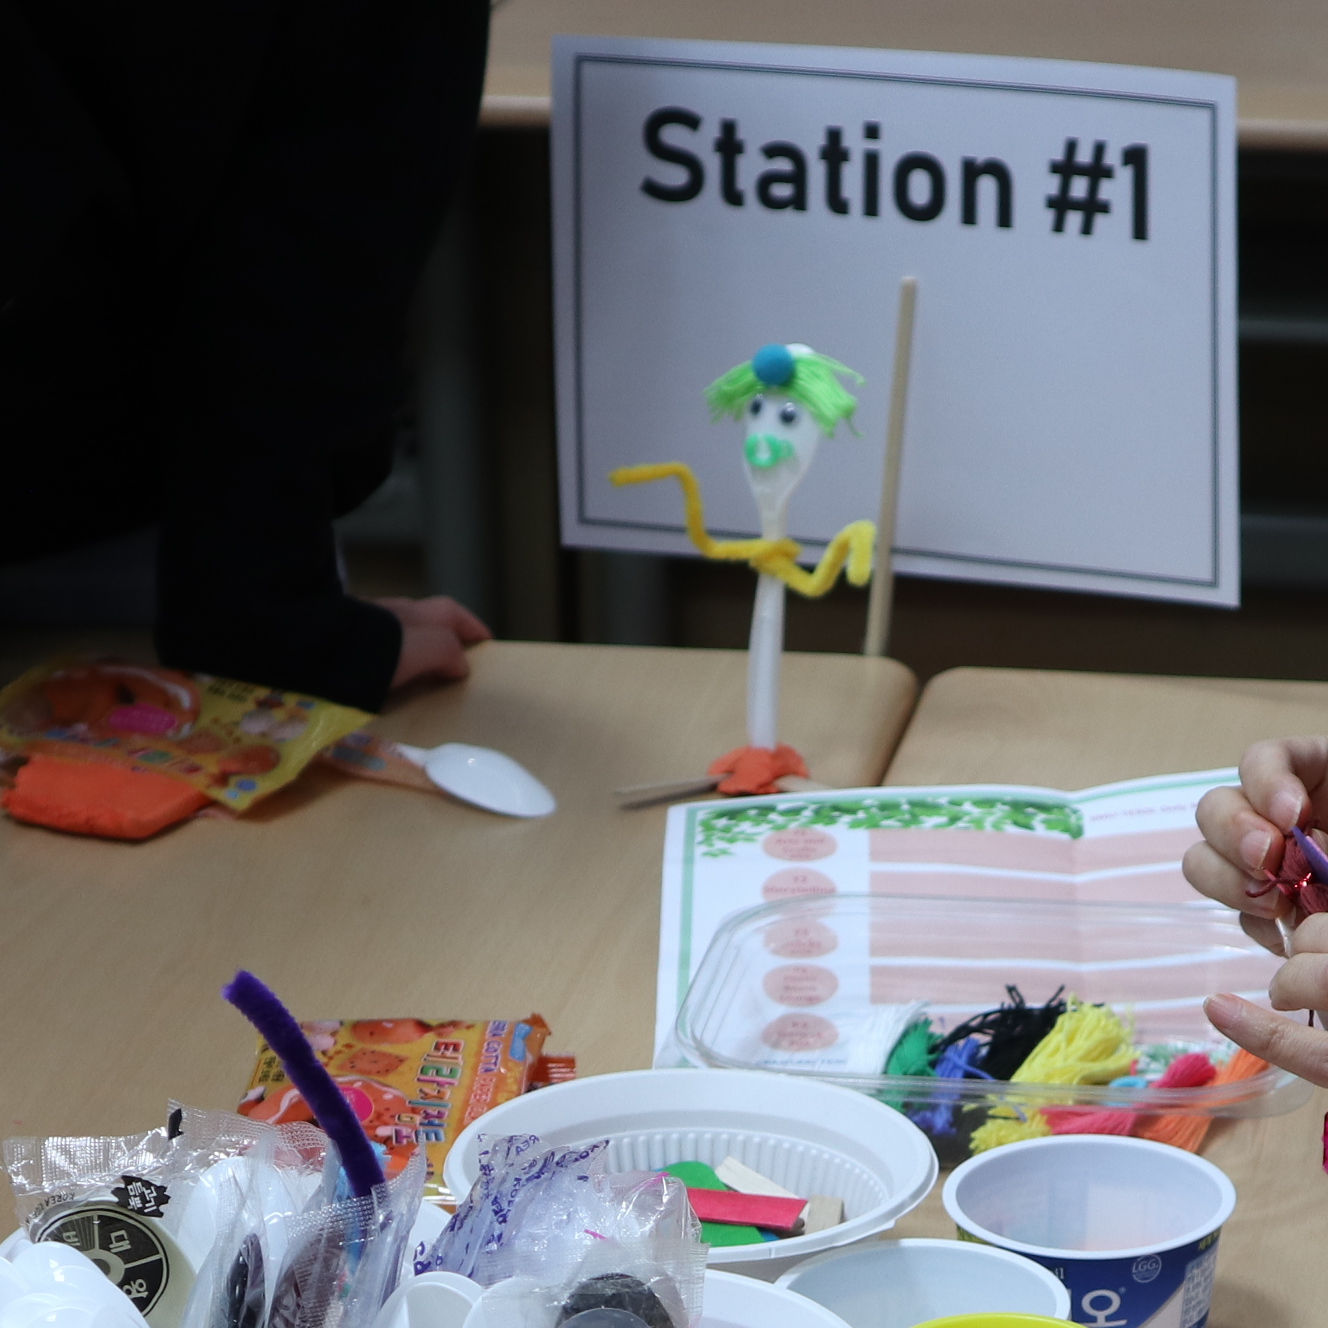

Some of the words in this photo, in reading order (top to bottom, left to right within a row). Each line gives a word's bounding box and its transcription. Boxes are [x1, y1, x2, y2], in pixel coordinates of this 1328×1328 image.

[640, 105, 1013, 230] Station
[1045, 136, 1150, 241] #1
[126, 1181, 143, 1211] 듬뿍
[143, 1184, 159, 1213] 고기
